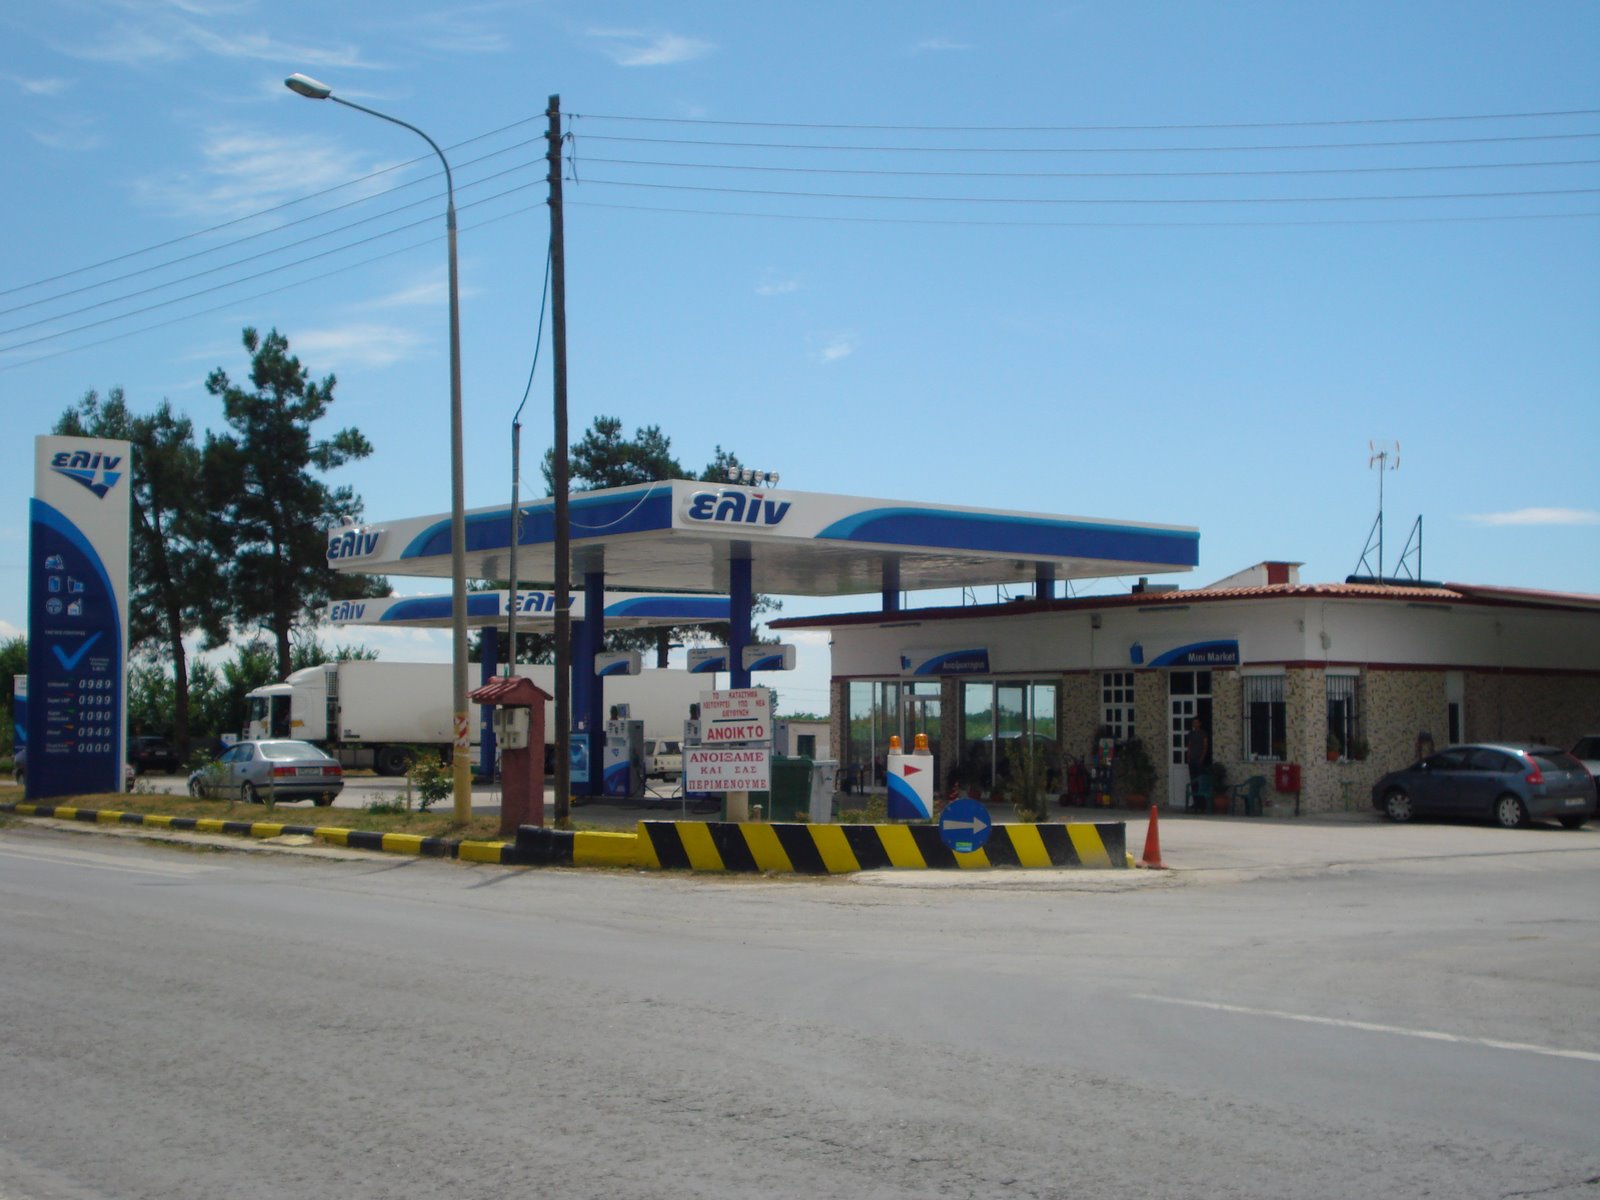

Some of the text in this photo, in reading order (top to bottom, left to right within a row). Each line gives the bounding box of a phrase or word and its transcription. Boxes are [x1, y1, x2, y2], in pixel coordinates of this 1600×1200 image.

[1188, 652, 1236, 663] Mini Market
[78, 679, 111, 689] 0989
[78, 695, 111, 705] 0999
[79, 711, 111, 721] 1090
[78, 727, 111, 737] 0949
[707, 725, 764, 740] ΑΝΟΙΚΤΟ
[690, 752, 764, 763] ΑΝΟΙΞΑΜΕ
[700, 766, 757, 775] ΚΑΙ ΣΑΣ
[688, 780, 767, 790] ΠΕΡΙΜΕΝΟΥΜΕ
